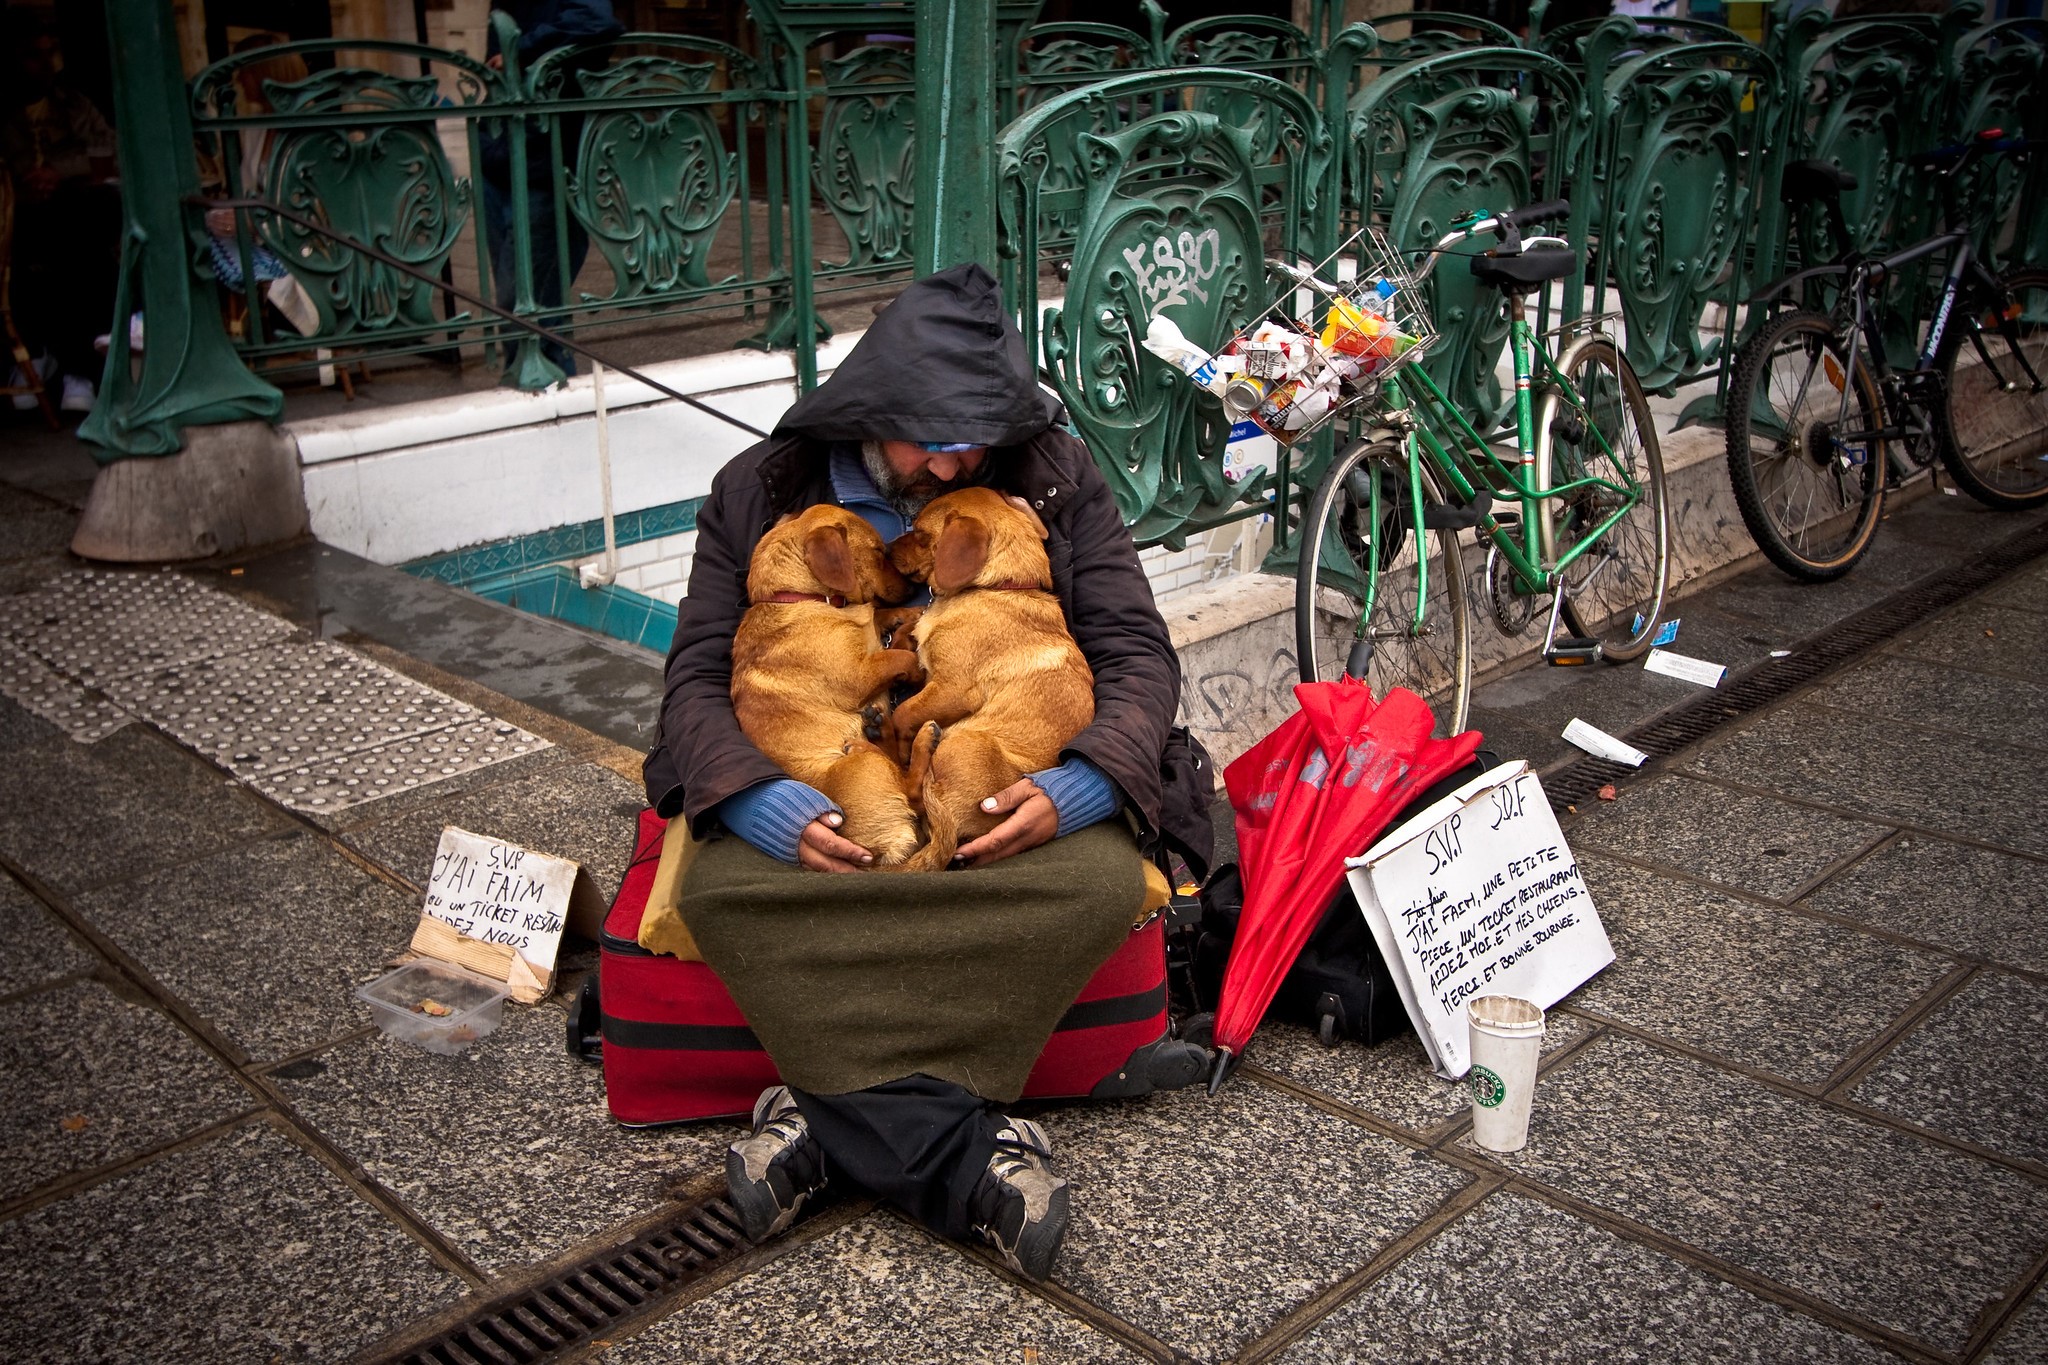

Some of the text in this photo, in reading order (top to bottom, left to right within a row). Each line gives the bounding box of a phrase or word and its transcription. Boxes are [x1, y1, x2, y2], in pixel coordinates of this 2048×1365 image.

[1425, 776, 1530, 875] S.V.P S.D.F
[487, 845, 525, 870] S.V.P
[1483, 873, 1506, 901] UNE
[1508, 846, 1560, 880] PETITE
[1460, 924, 1477, 951] UN
[1478, 897, 1517, 933] TICKET
[1517, 863, 1579, 907] RESTAURANT
[1514, 911, 1535, 935] MES
[482, 927, 530, 949] NOUS
[1484, 962, 1498, 983] ET
[1500, 941, 1535, 970] BONNE
